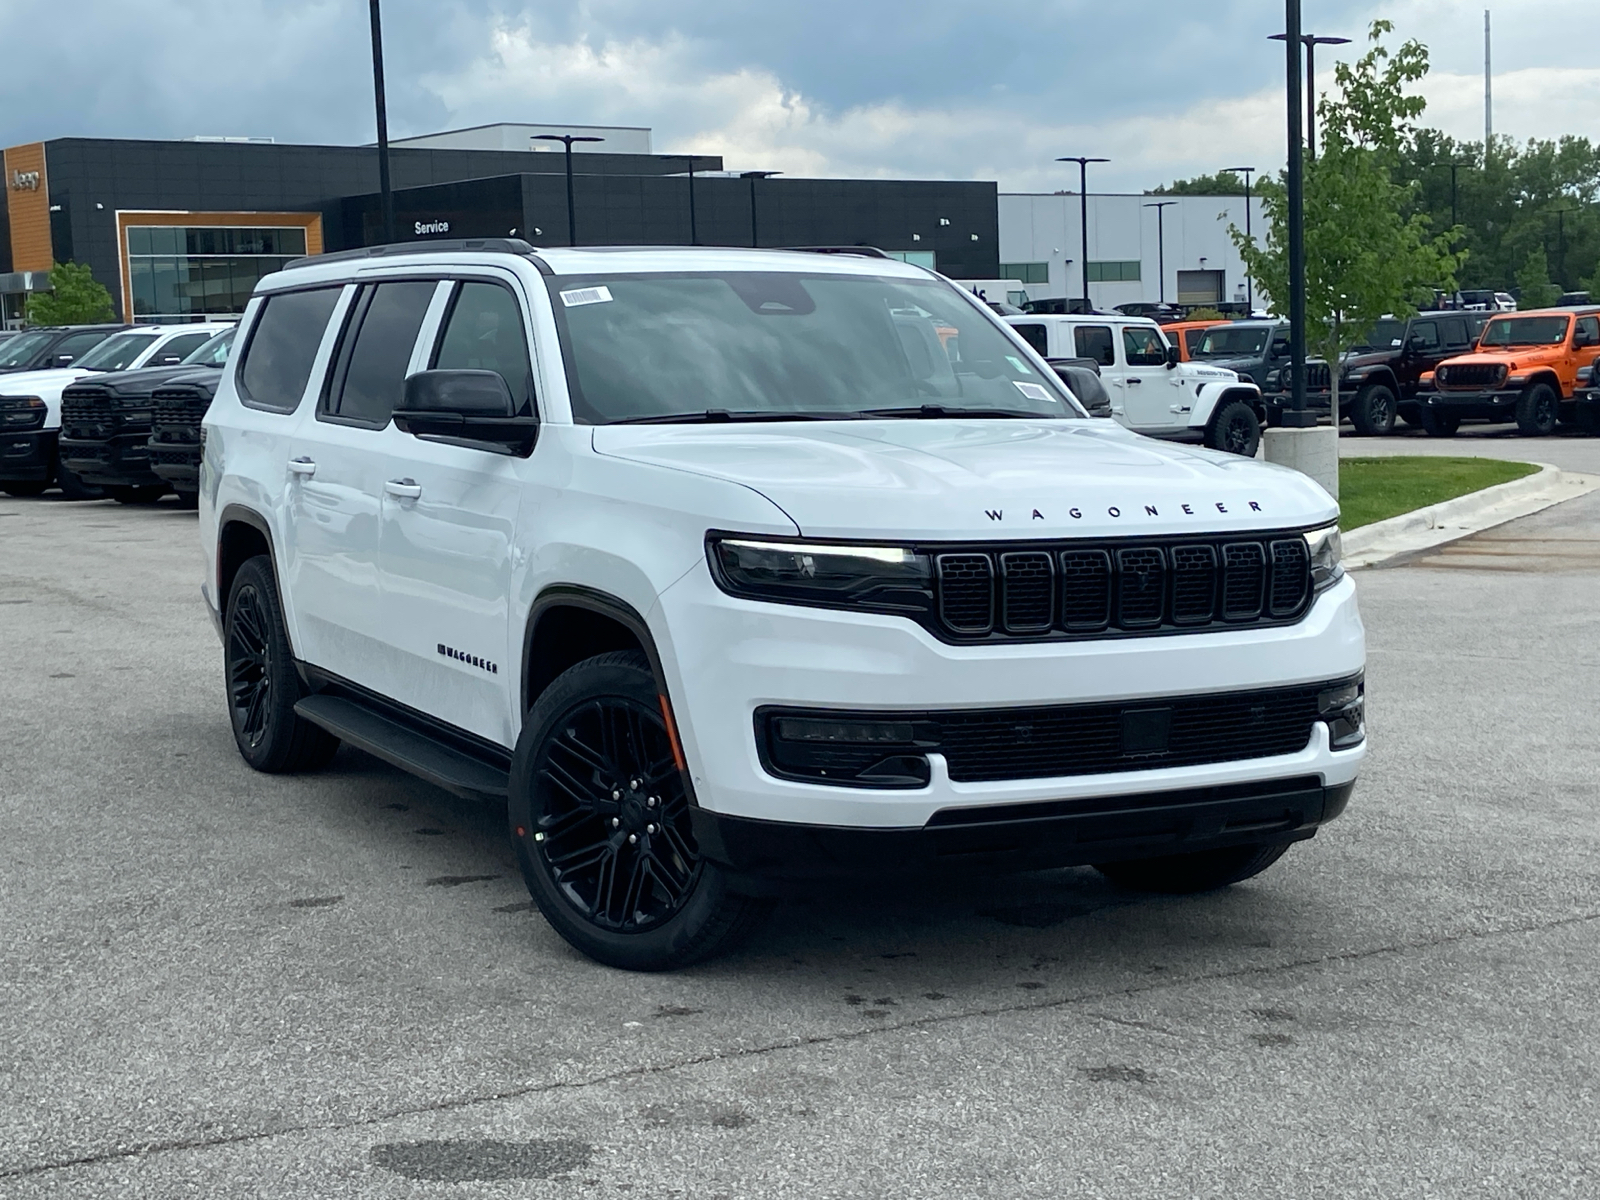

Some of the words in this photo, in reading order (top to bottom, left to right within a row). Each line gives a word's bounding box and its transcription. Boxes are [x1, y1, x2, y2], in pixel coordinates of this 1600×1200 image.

[12, 169, 39, 191] Jeep
[415, 220, 449, 235] Service
[985, 501, 1262, 521] WAGONEER
[446, 646, 498, 674] WAGONEER
